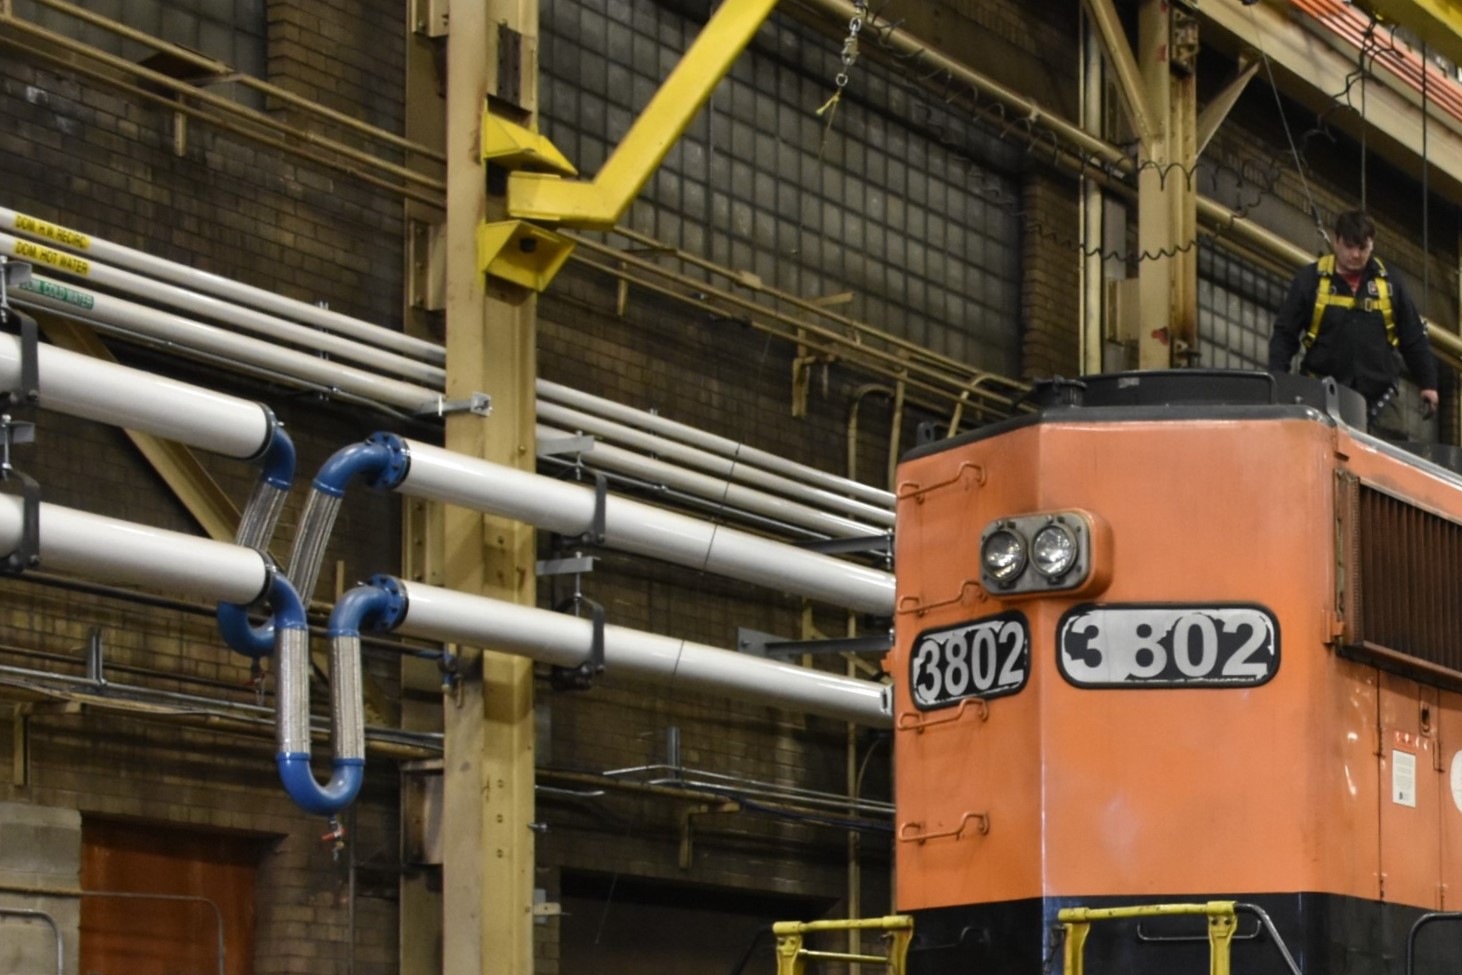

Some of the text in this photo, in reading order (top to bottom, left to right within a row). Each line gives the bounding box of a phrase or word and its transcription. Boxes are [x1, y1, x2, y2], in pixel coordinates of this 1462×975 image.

[41, 249, 57, 264] HOT
[60, 256, 88, 276] WATER
[67, 290, 93, 309] WATER
[917, 620, 1025, 701] 3802
[1071, 612, 1268, 679] 3802
